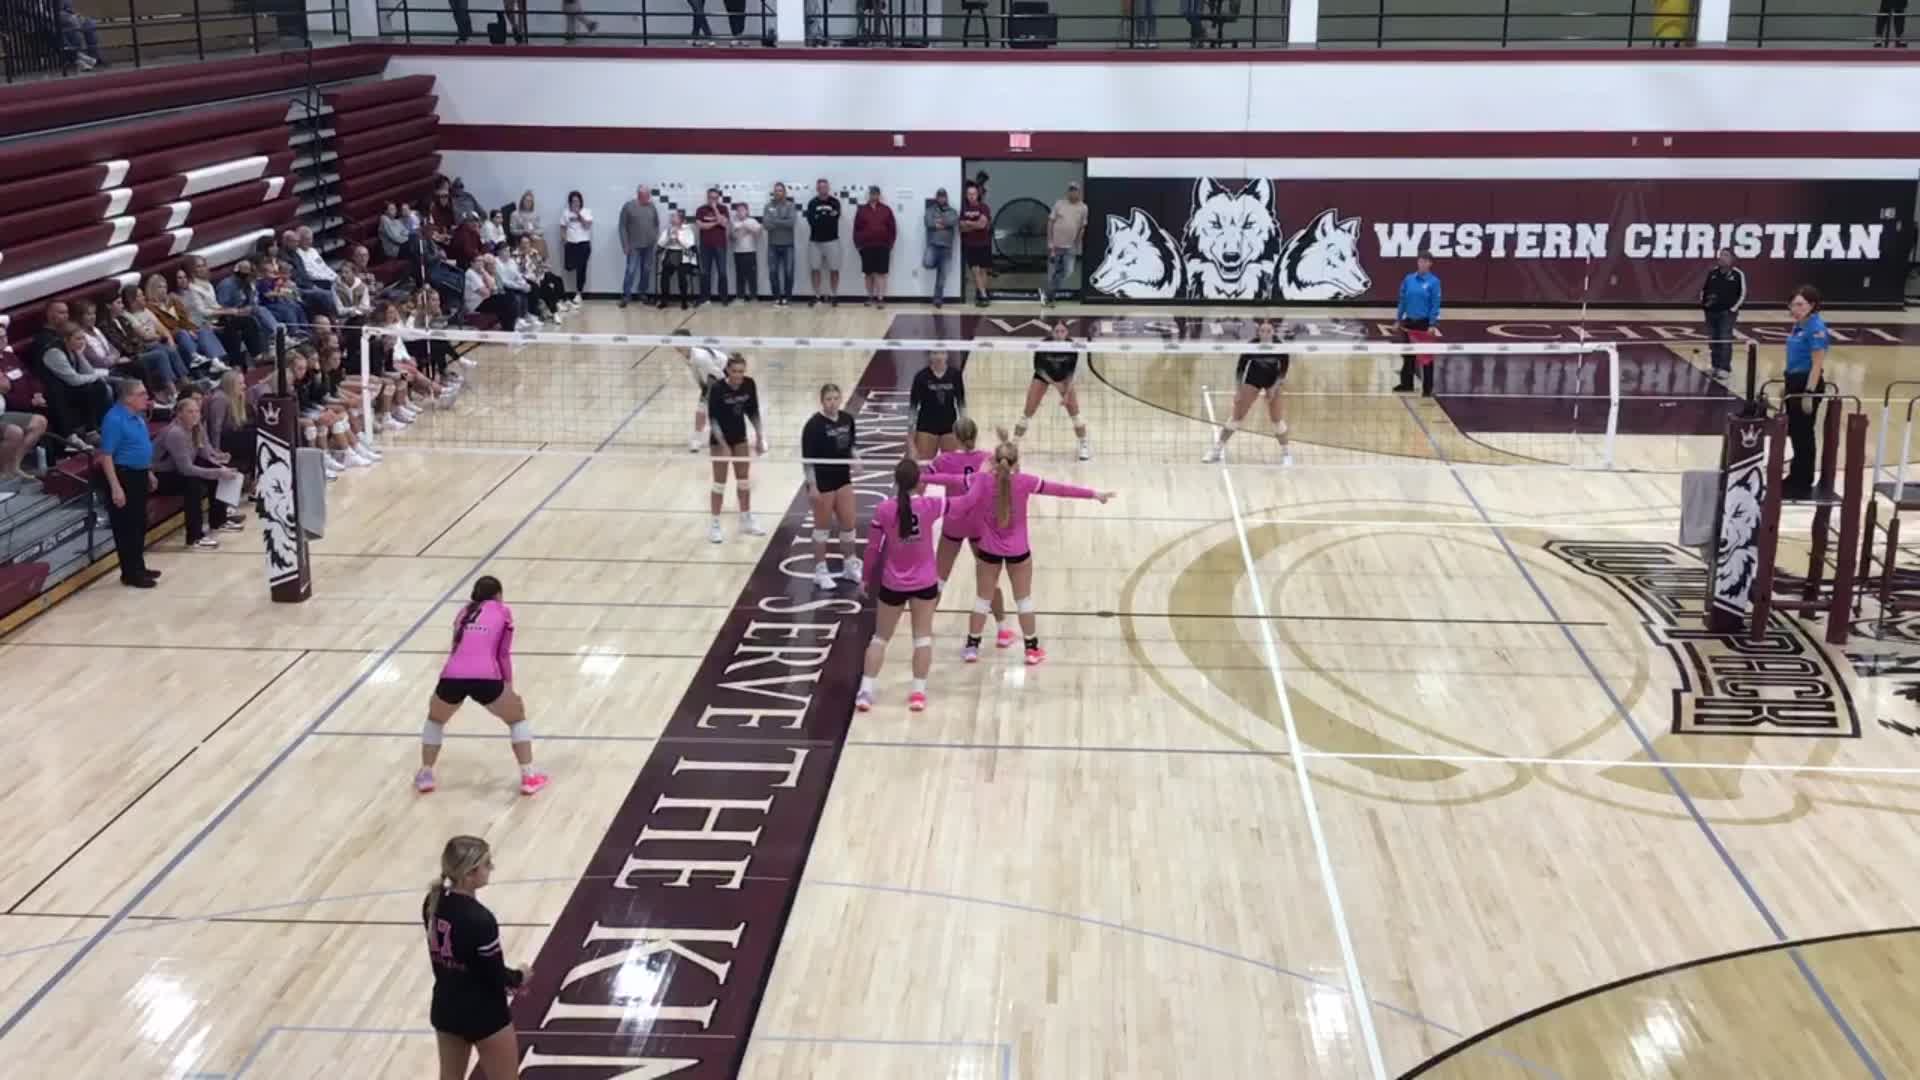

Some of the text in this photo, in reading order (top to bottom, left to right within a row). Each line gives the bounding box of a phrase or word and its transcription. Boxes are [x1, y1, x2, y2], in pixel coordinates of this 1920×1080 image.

[1374, 223, 1883, 259] WESTERN CHRISTIAN
[697, 597, 862, 728] SERVE
[614, 748, 810, 889] THE
